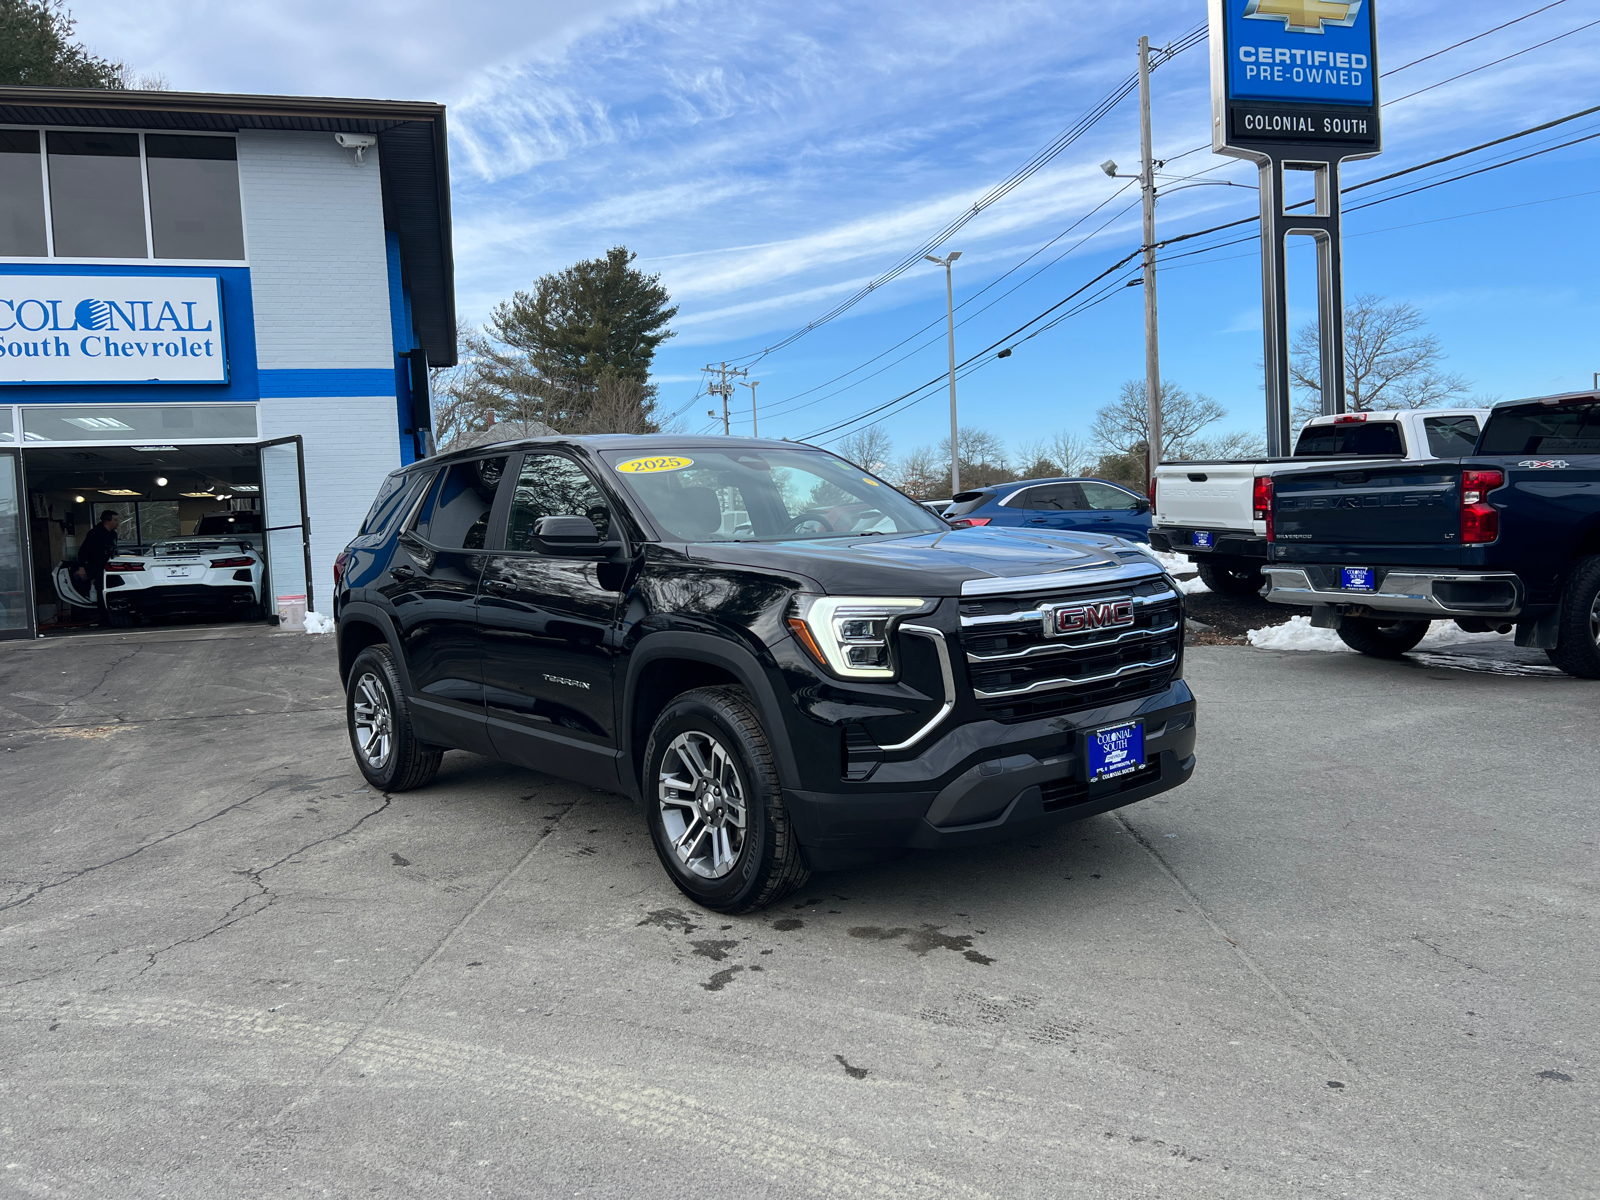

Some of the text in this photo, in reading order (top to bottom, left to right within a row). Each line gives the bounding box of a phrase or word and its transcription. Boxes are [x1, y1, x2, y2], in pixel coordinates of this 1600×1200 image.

[1239, 46, 1368, 69] CERTIFIED
[1246, 65, 1362, 86] PRE-OWNED
[1245, 114, 1367, 134] COLONIAL SOUTH
[0, 298, 212, 332] COLONIAL
[80, 336, 214, 357] Chevrolet
[631, 457, 681, 471] 2025
[1161, 488, 1238, 498] CHEVROLET
[1278, 494, 1444, 511] CHEVROLET
[1056, 601, 1134, 632] GMC
[542, 673, 590, 690] TERRAIN
[1097, 729, 1133, 745] COLONIAL
[1103, 739, 1128, 753] SOUTH
